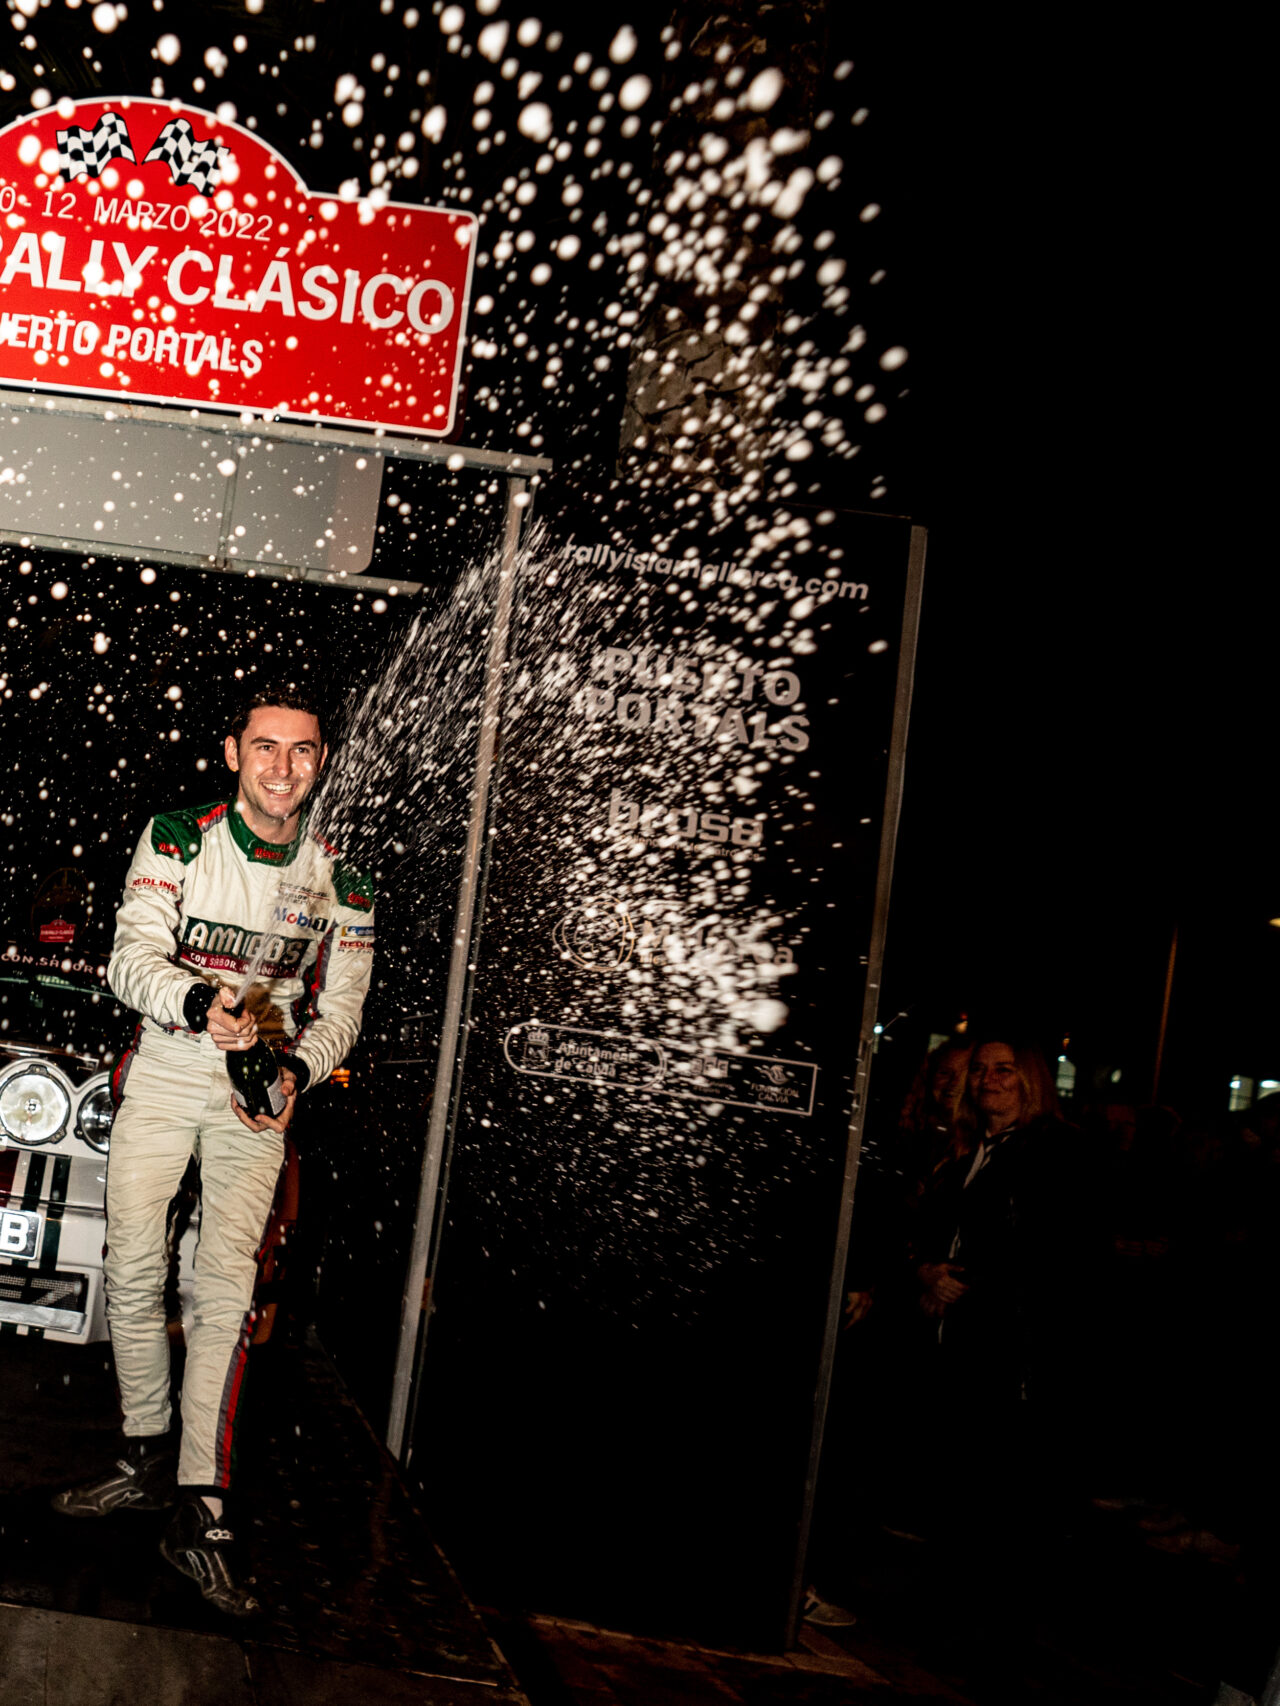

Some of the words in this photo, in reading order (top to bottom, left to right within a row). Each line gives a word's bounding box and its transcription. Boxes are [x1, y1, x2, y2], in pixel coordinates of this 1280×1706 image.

[41, 191, 77, 220] 12
[93, 197, 191, 233] MARZO
[199, 208, 273, 242] 2022
[167, 247, 455, 335] CLÁSICO
[107, 323, 263, 377] PORTALS
[131, 877, 179, 894] REDLINE
[1, 952, 34, 964] CON
[39, 956, 94, 974] SAOR
[187, 922, 303, 965] AMIGOS
[190, 952, 208, 967] CON
[210, 957, 237, 969] SABOR
